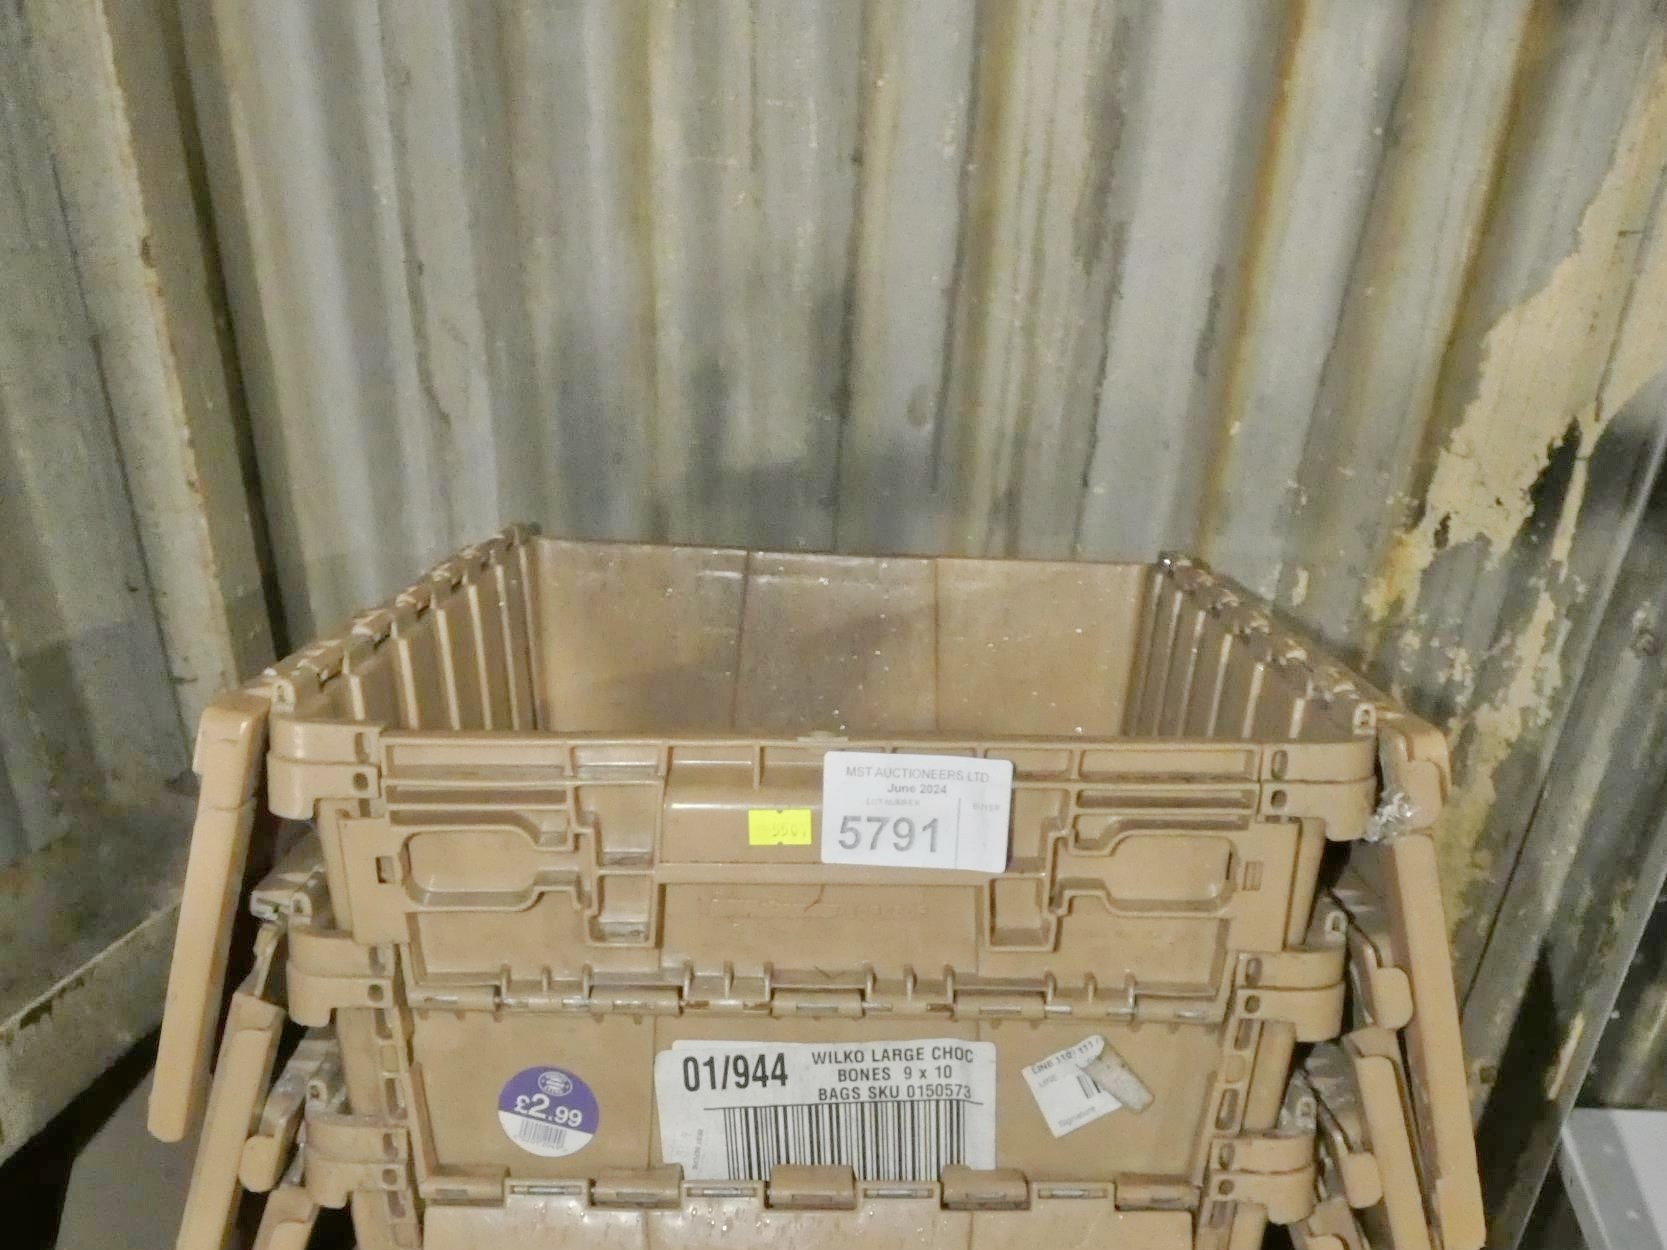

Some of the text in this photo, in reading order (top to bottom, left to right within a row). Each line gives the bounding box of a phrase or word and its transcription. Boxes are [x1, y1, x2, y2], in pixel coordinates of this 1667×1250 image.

[846, 766, 990, 784] MST AUCTIONEERS LTD
[887, 783, 948, 795] June 2024
[838, 814, 940, 853] 5791
[811, 1046, 974, 1066] WILKO LARGE CHOC
[682, 1052, 788, 1092] 01/944
[838, 1065, 953, 1083] BONES 9 x 10
[818, 1083, 972, 1102] BAGS SKU 0150573
[514, 1092, 583, 1128] £2.99
